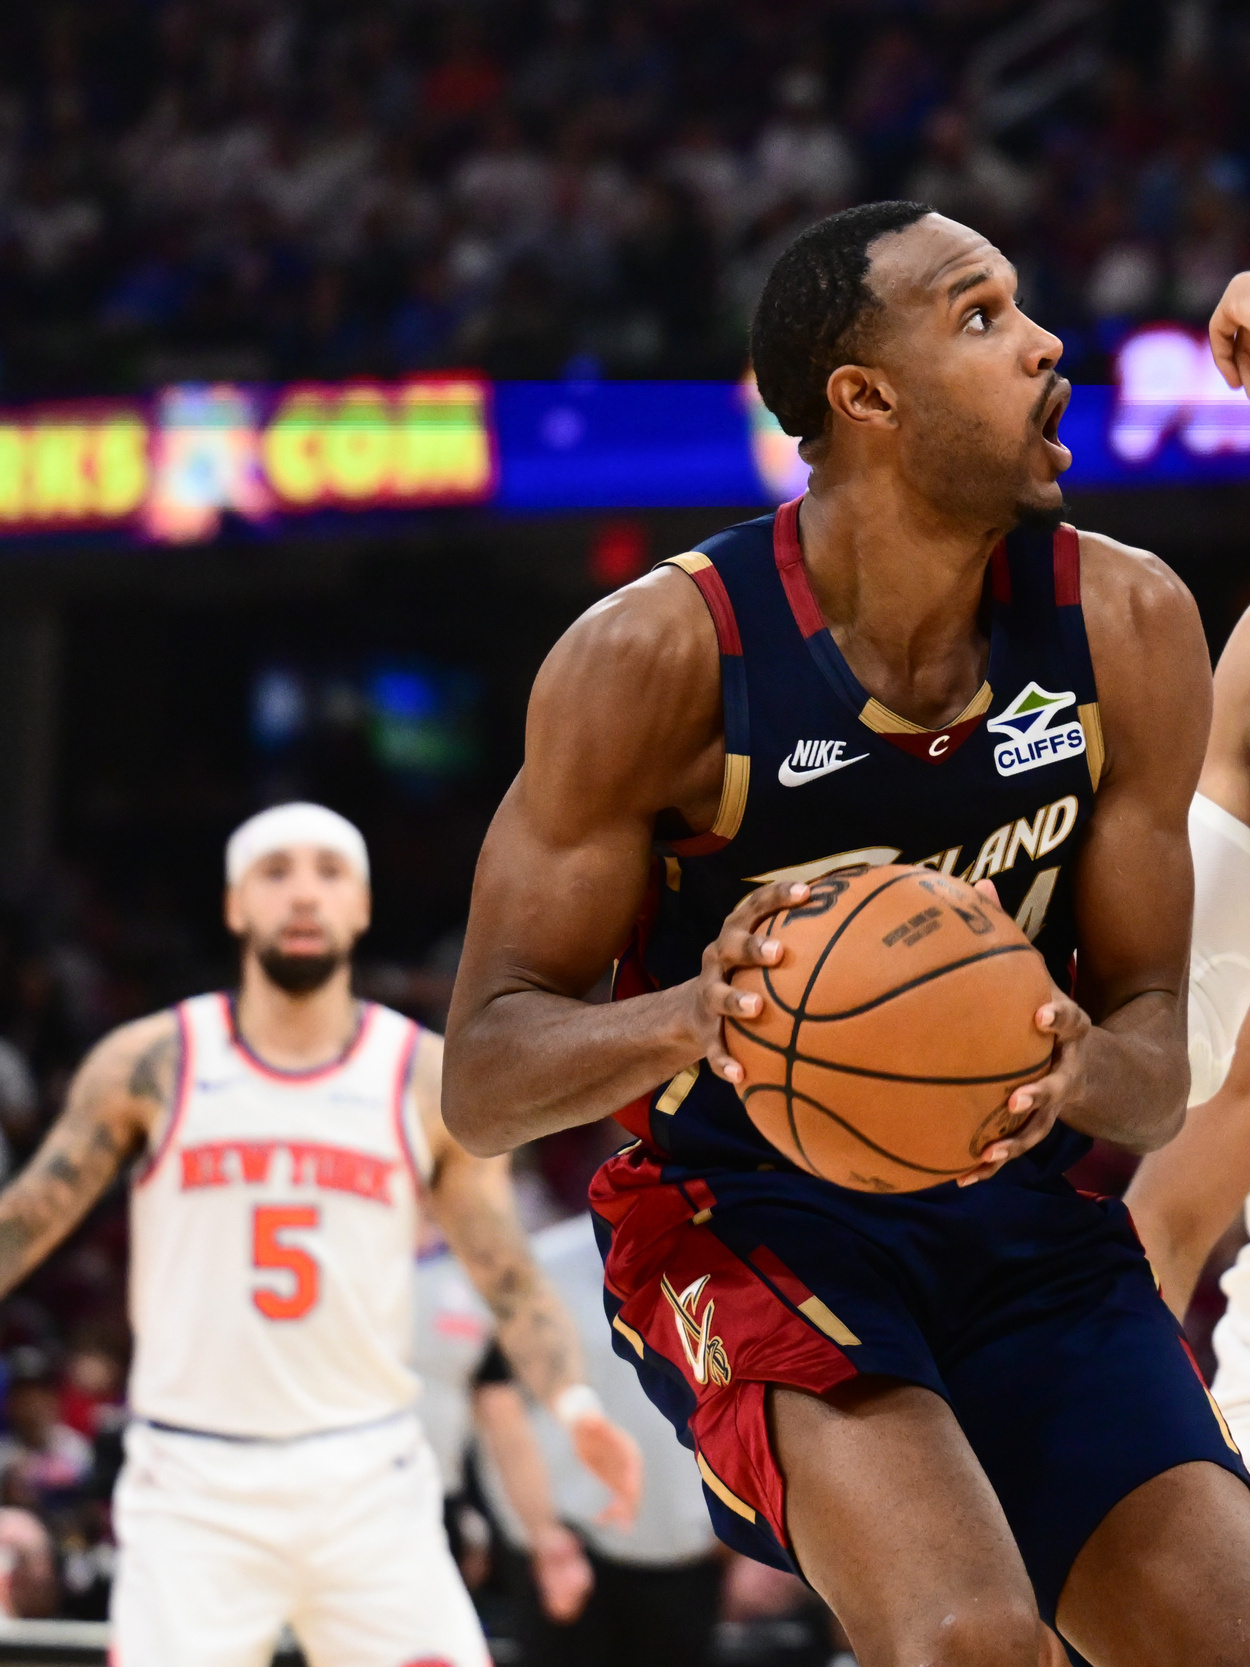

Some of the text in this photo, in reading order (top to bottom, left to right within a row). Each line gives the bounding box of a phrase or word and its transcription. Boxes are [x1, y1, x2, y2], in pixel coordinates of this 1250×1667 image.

[791, 739, 847, 767] NIKE
[997, 728, 1083, 769] CLIFFS
[179, 1138, 398, 1209] NEW YORK
[251, 1203, 321, 1322] 5
